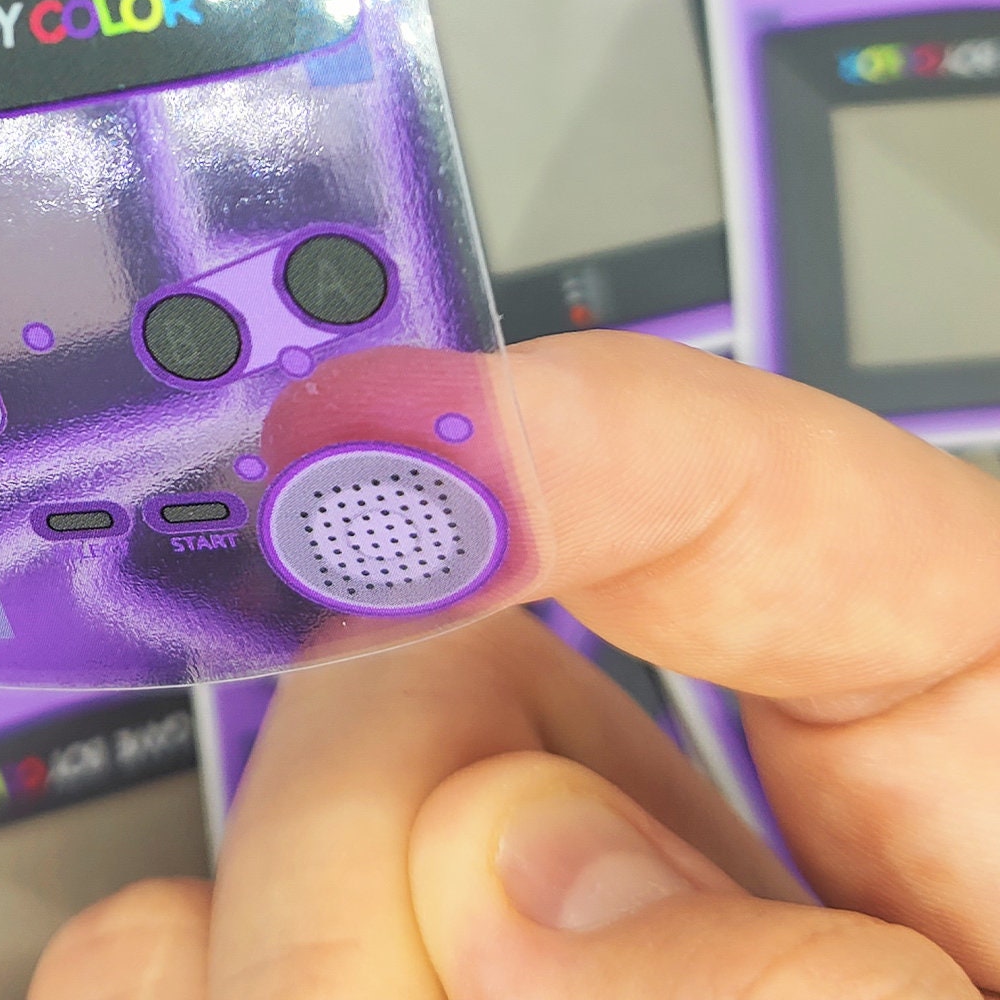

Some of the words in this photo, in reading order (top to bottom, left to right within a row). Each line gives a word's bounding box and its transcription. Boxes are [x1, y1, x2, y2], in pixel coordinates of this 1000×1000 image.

[315, 257, 355, 307] A
[163, 318, 200, 366] B
[170, 532, 238, 553] START
